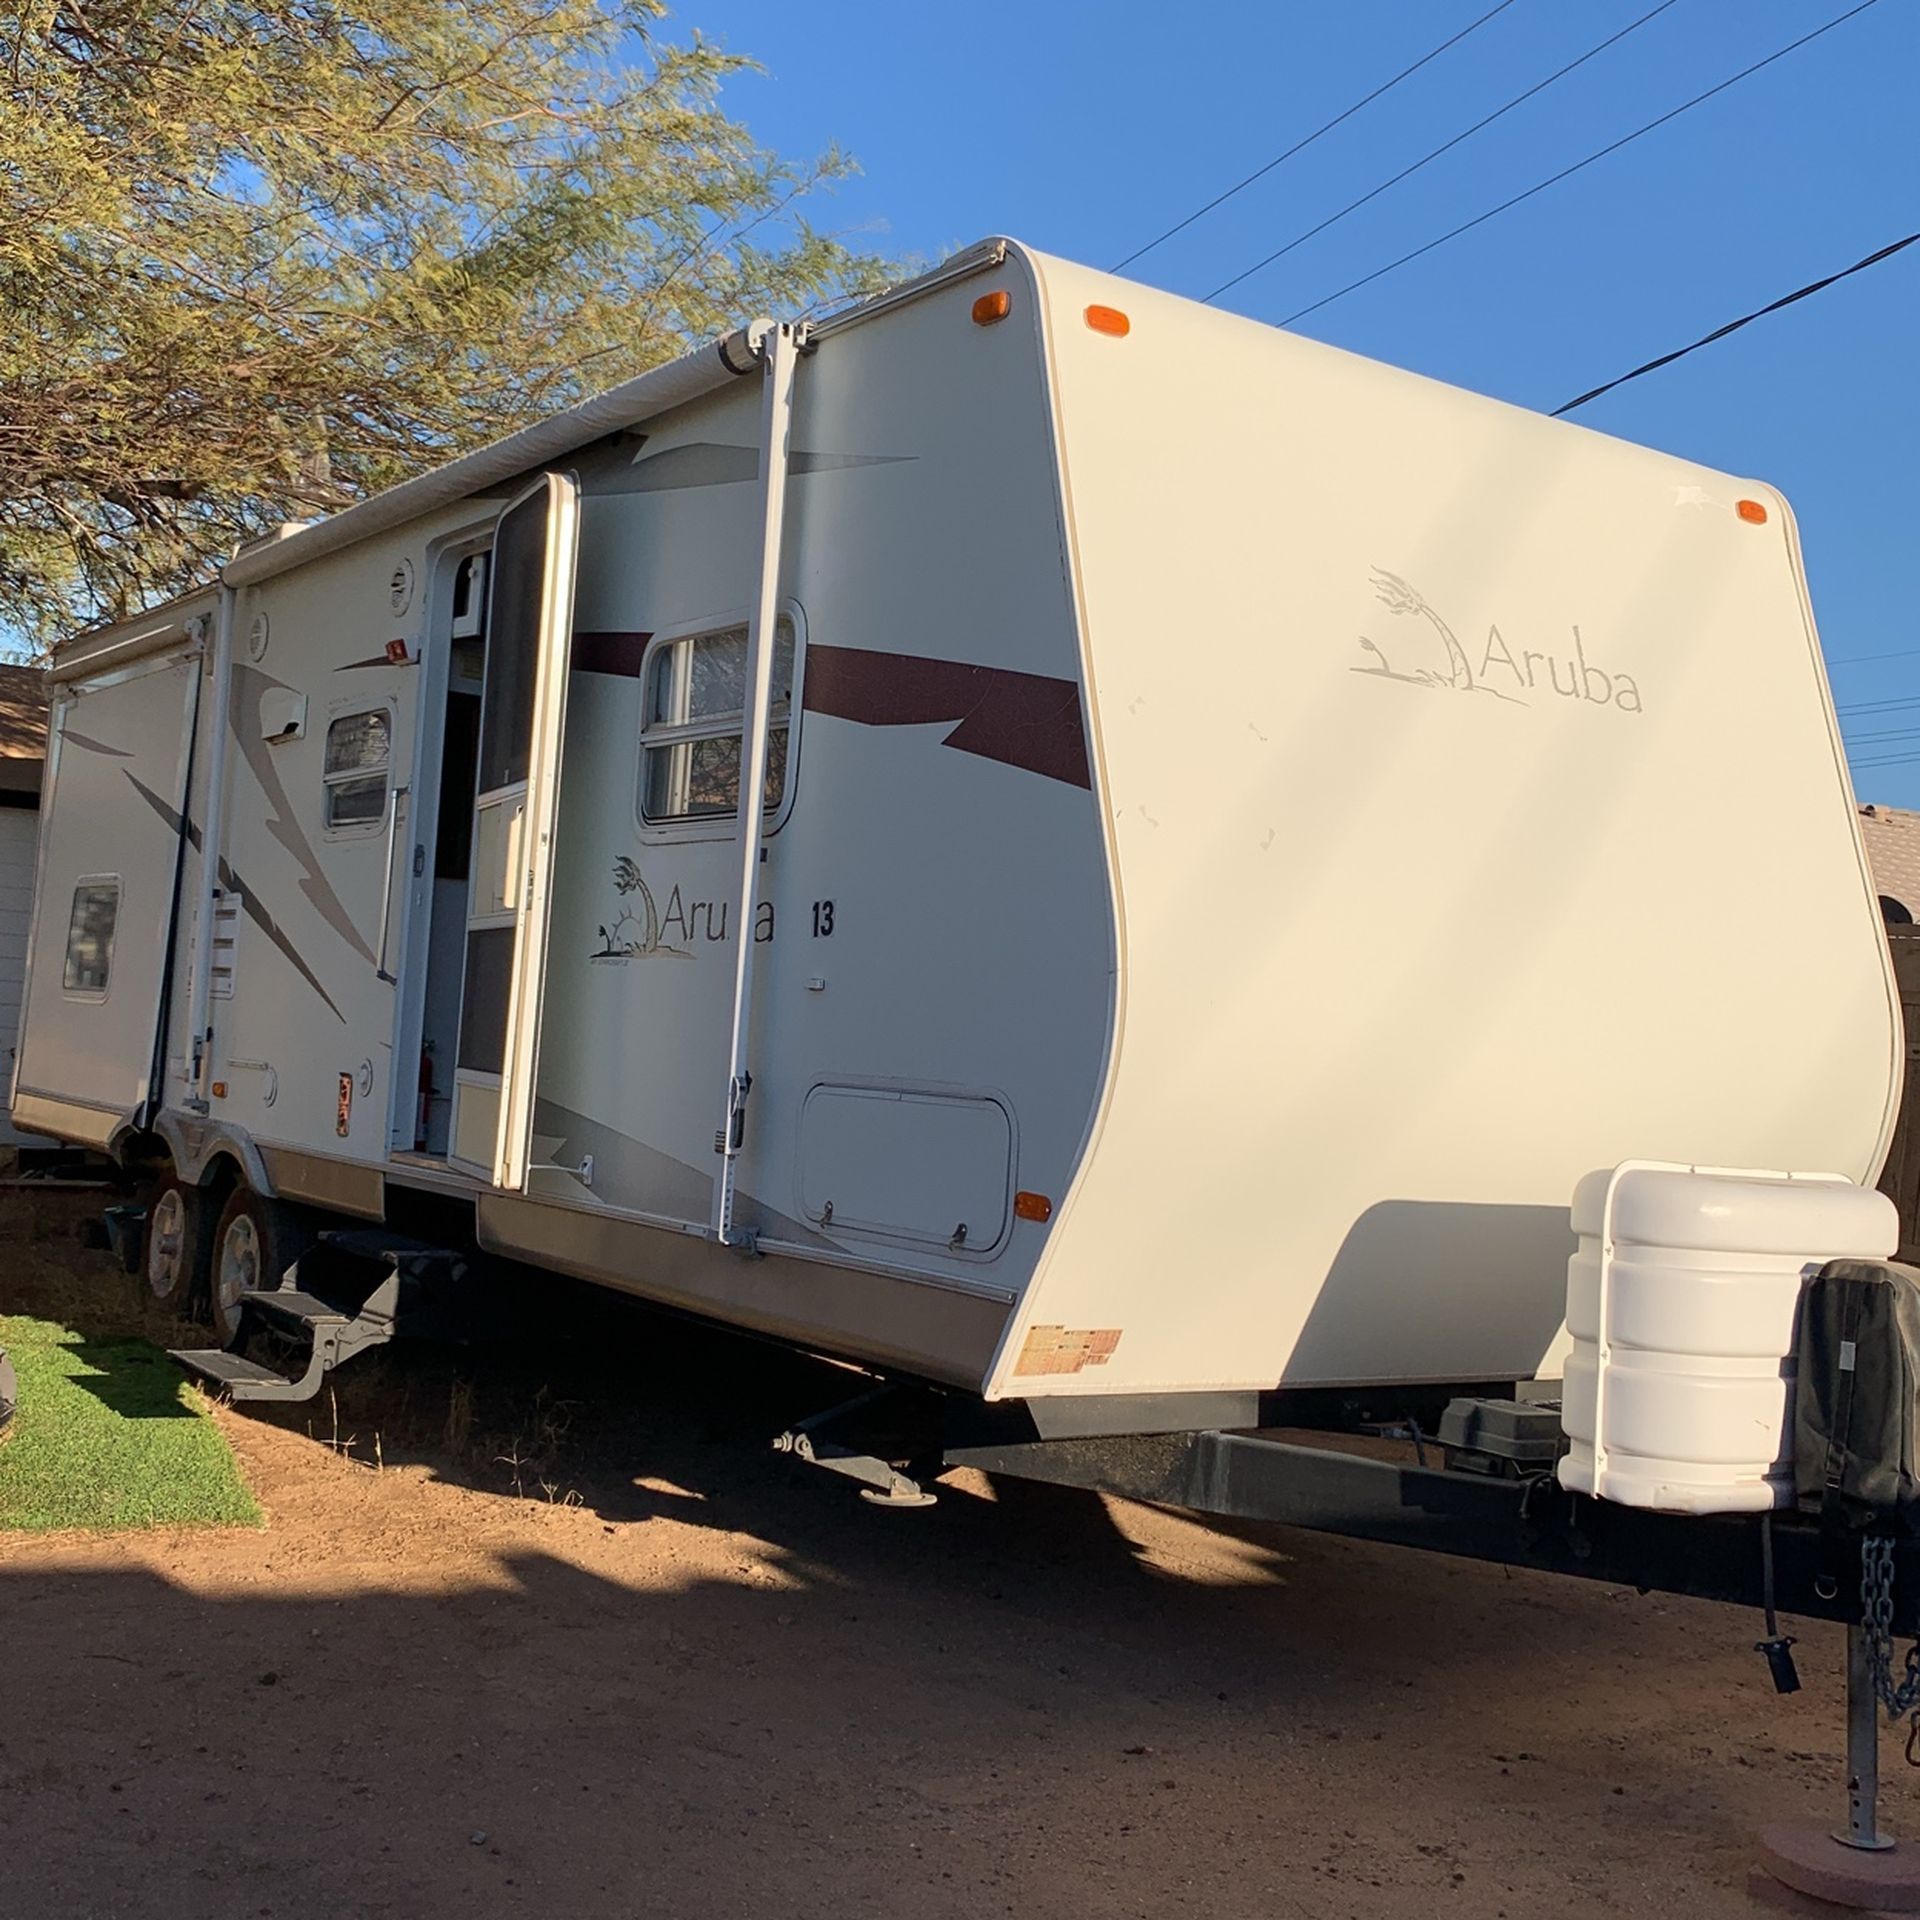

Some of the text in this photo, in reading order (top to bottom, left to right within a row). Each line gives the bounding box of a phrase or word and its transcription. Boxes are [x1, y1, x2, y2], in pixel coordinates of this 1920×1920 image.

[1480, 624, 1642, 713] Aruba
[658, 884, 774, 942] Arua
[812, 900, 834, 938] 13
